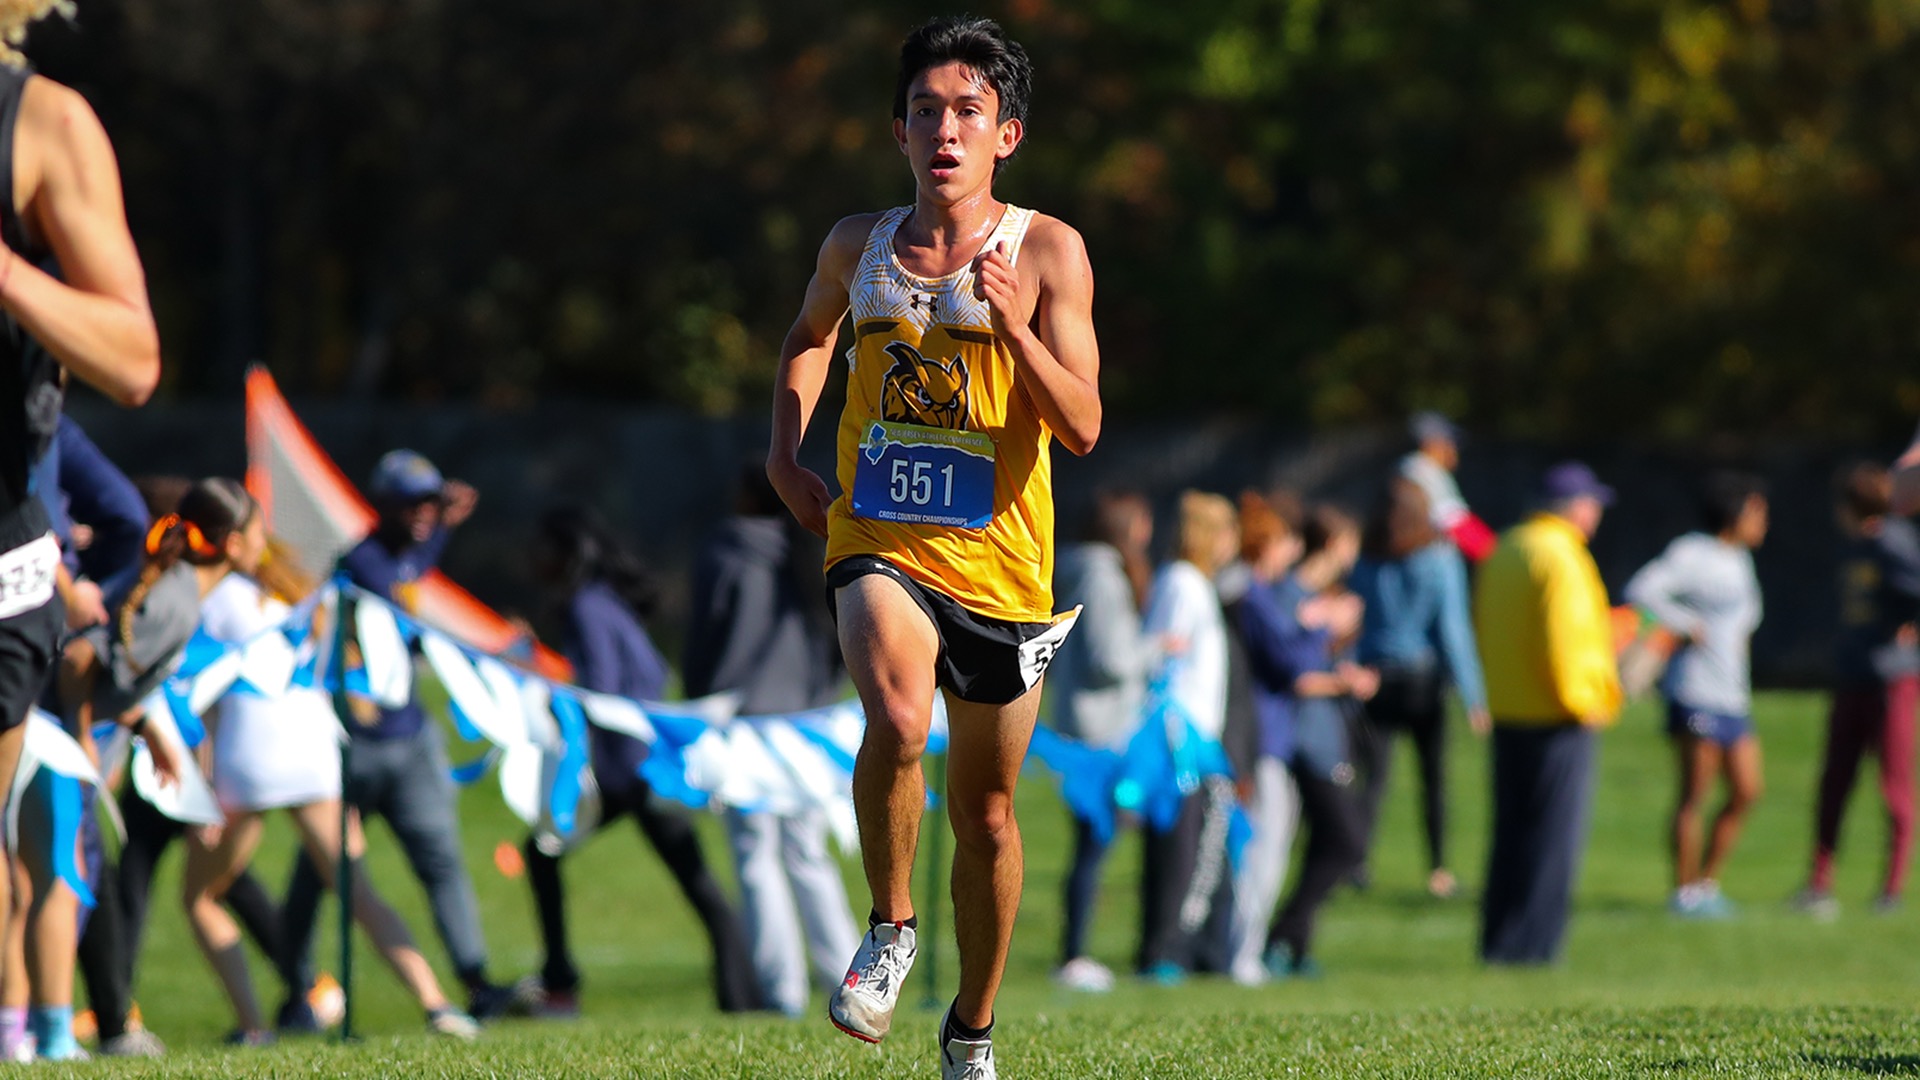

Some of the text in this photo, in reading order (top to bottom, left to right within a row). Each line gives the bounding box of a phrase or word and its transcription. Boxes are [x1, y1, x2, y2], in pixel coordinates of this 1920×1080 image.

[903, 429, 921, 439] JERSEY
[922, 431, 947, 442] ATHLETIC
[948, 434, 983, 447] CONFERENCE
[890, 459, 954, 507] 551
[878, 510, 968, 526] CROSS COUNTRY CHAMPIONSHIPS
